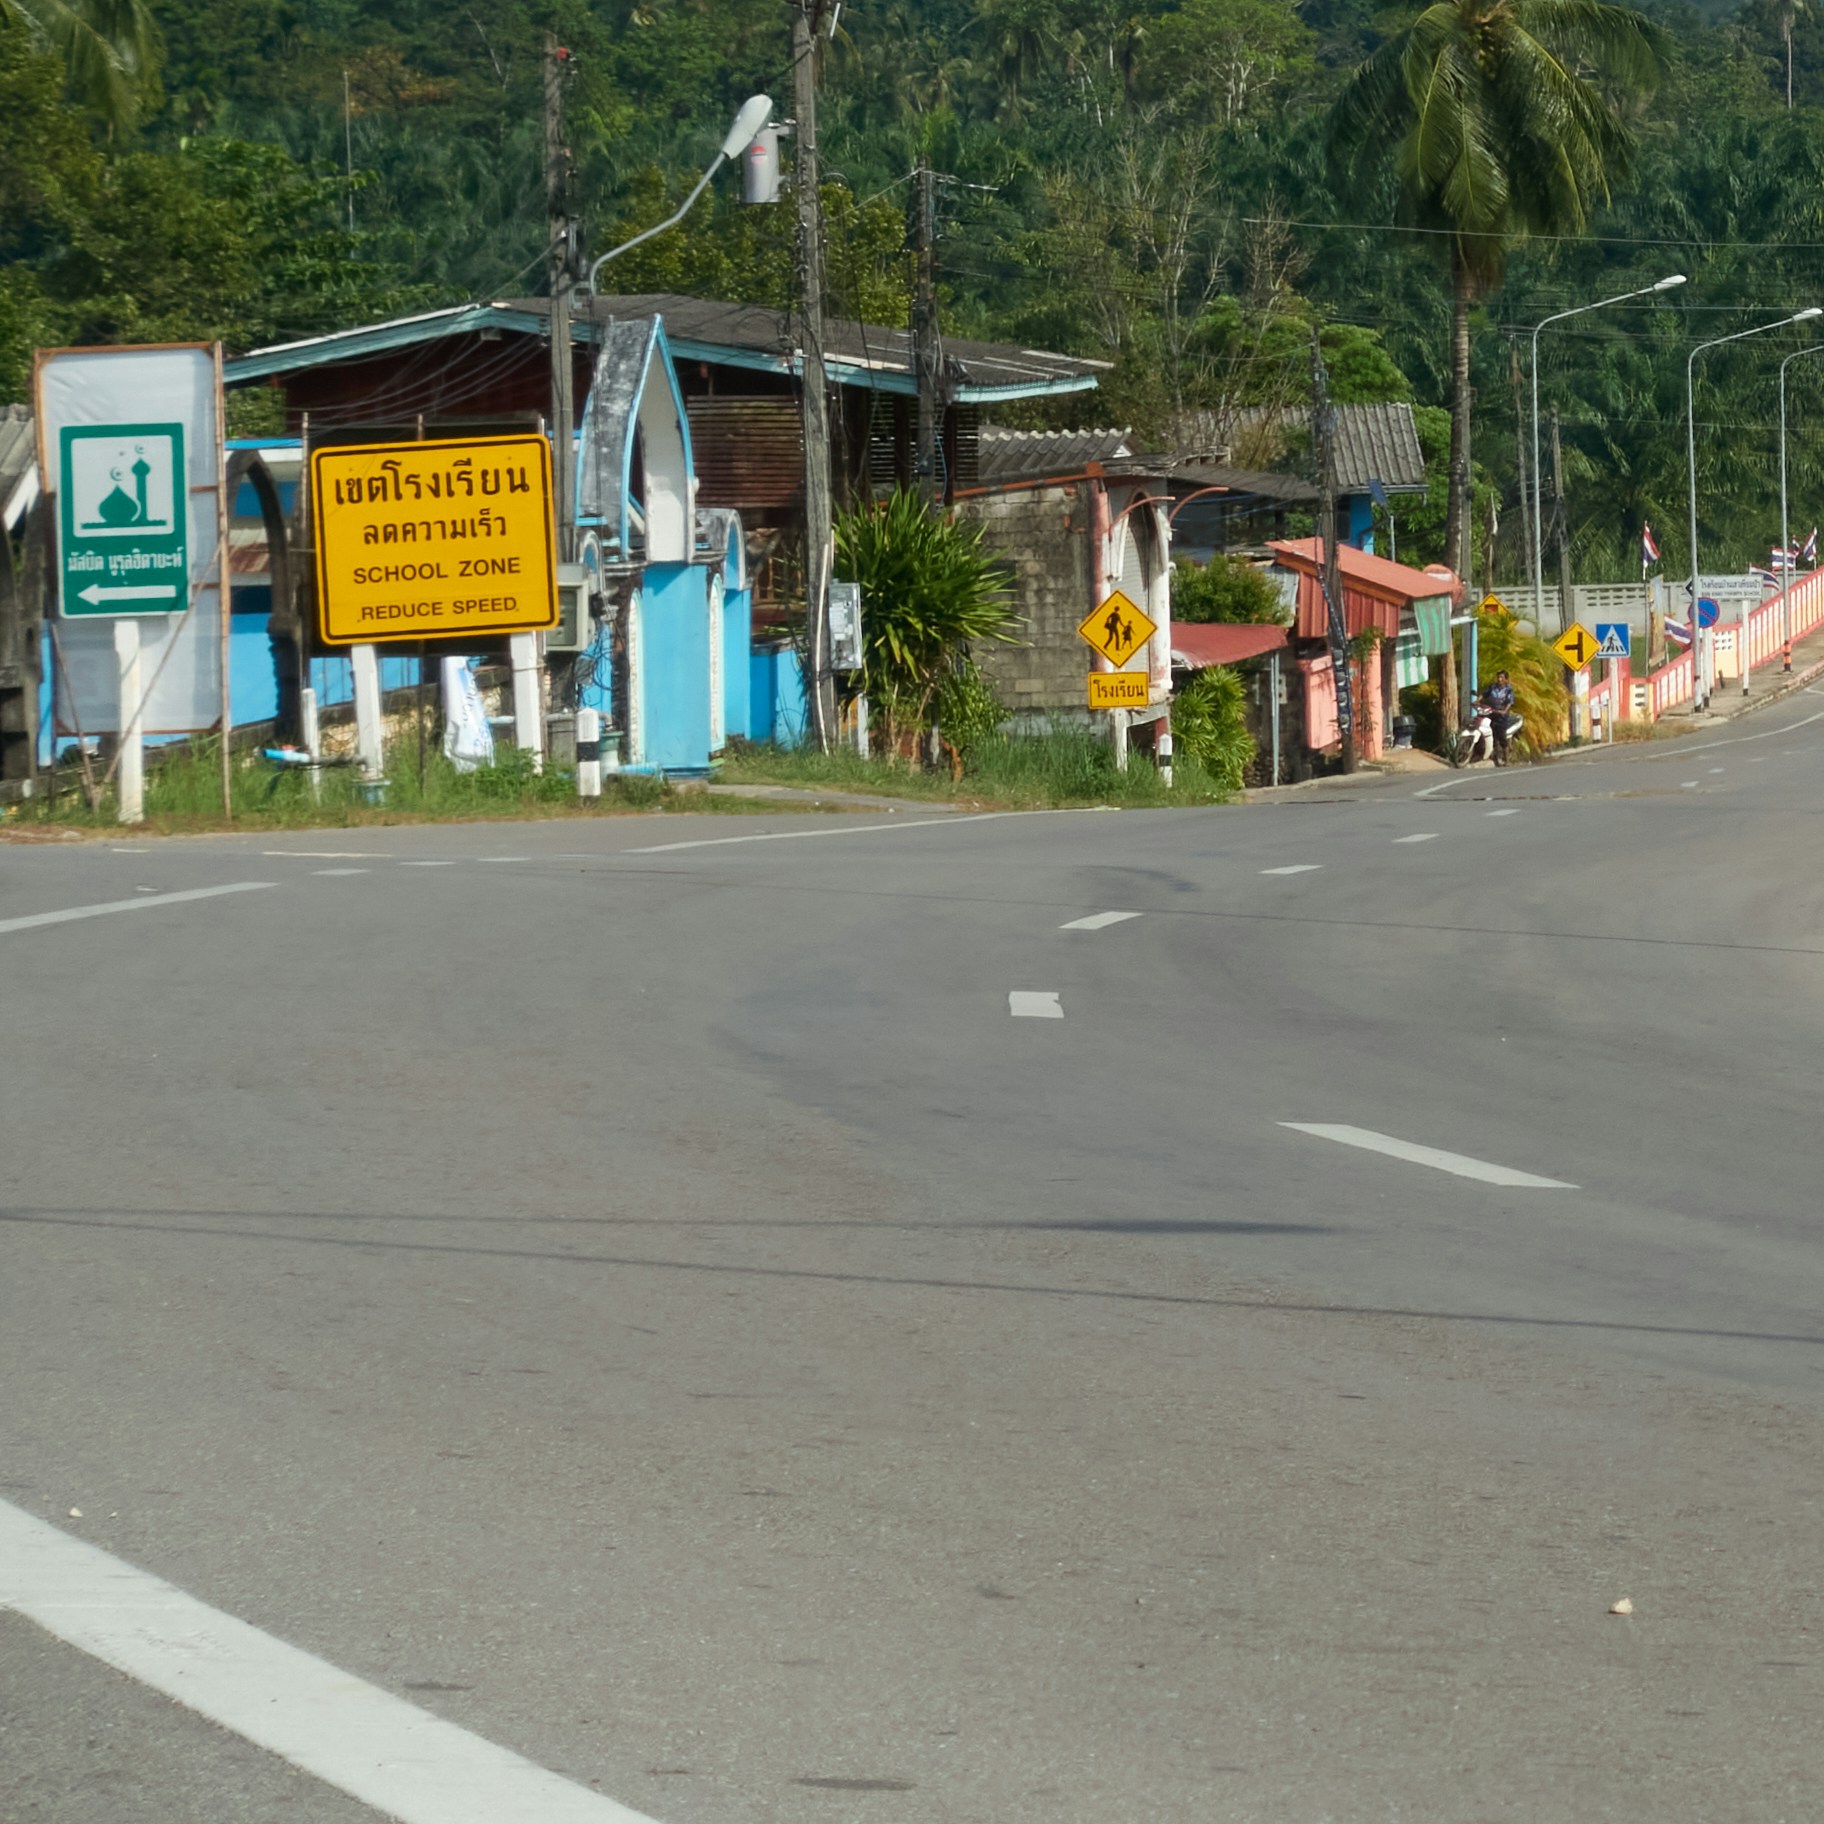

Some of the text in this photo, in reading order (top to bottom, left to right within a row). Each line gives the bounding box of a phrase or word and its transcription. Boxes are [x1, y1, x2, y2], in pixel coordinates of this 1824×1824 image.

[335, 458, 529, 504] เขตโรงเรียน
[363, 508, 506, 545] ลดความเร็ว
[353, 557, 521, 584] SCHOOL ZONE
[361, 597, 517, 621] REDUCE SPEED
[1093, 679, 1145, 698] โรงเรียน
